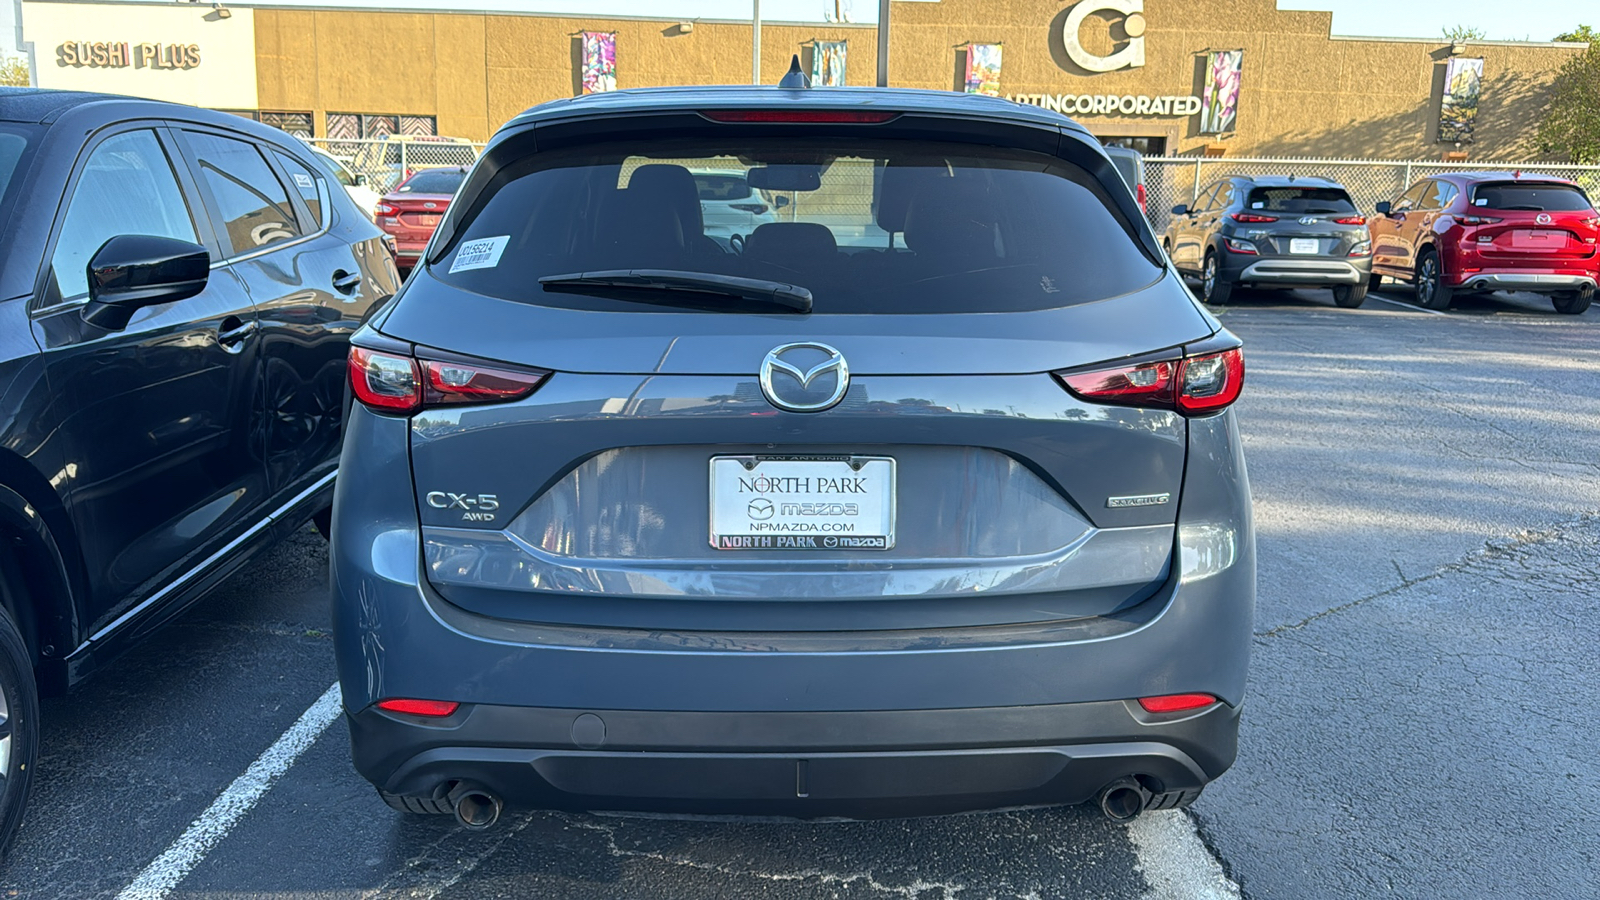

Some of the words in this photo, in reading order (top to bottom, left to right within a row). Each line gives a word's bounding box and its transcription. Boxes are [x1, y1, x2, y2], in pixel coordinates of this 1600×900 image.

[62, 41, 130, 65] SUSHI
[141, 43, 200, 67] PLUS
[738, 477, 810, 493] NORTH
[817, 477, 868, 493] PARK
[426, 491, 499, 511] CX-5
[781, 502, 859, 515] mazda
[462, 512, 495, 521] AWD
[750, 523, 855, 532] NPMAZDA.COM
[722, 536, 771, 547] NORTH
[777, 536, 817, 548] PARK
[840, 537, 884, 547] mazda
